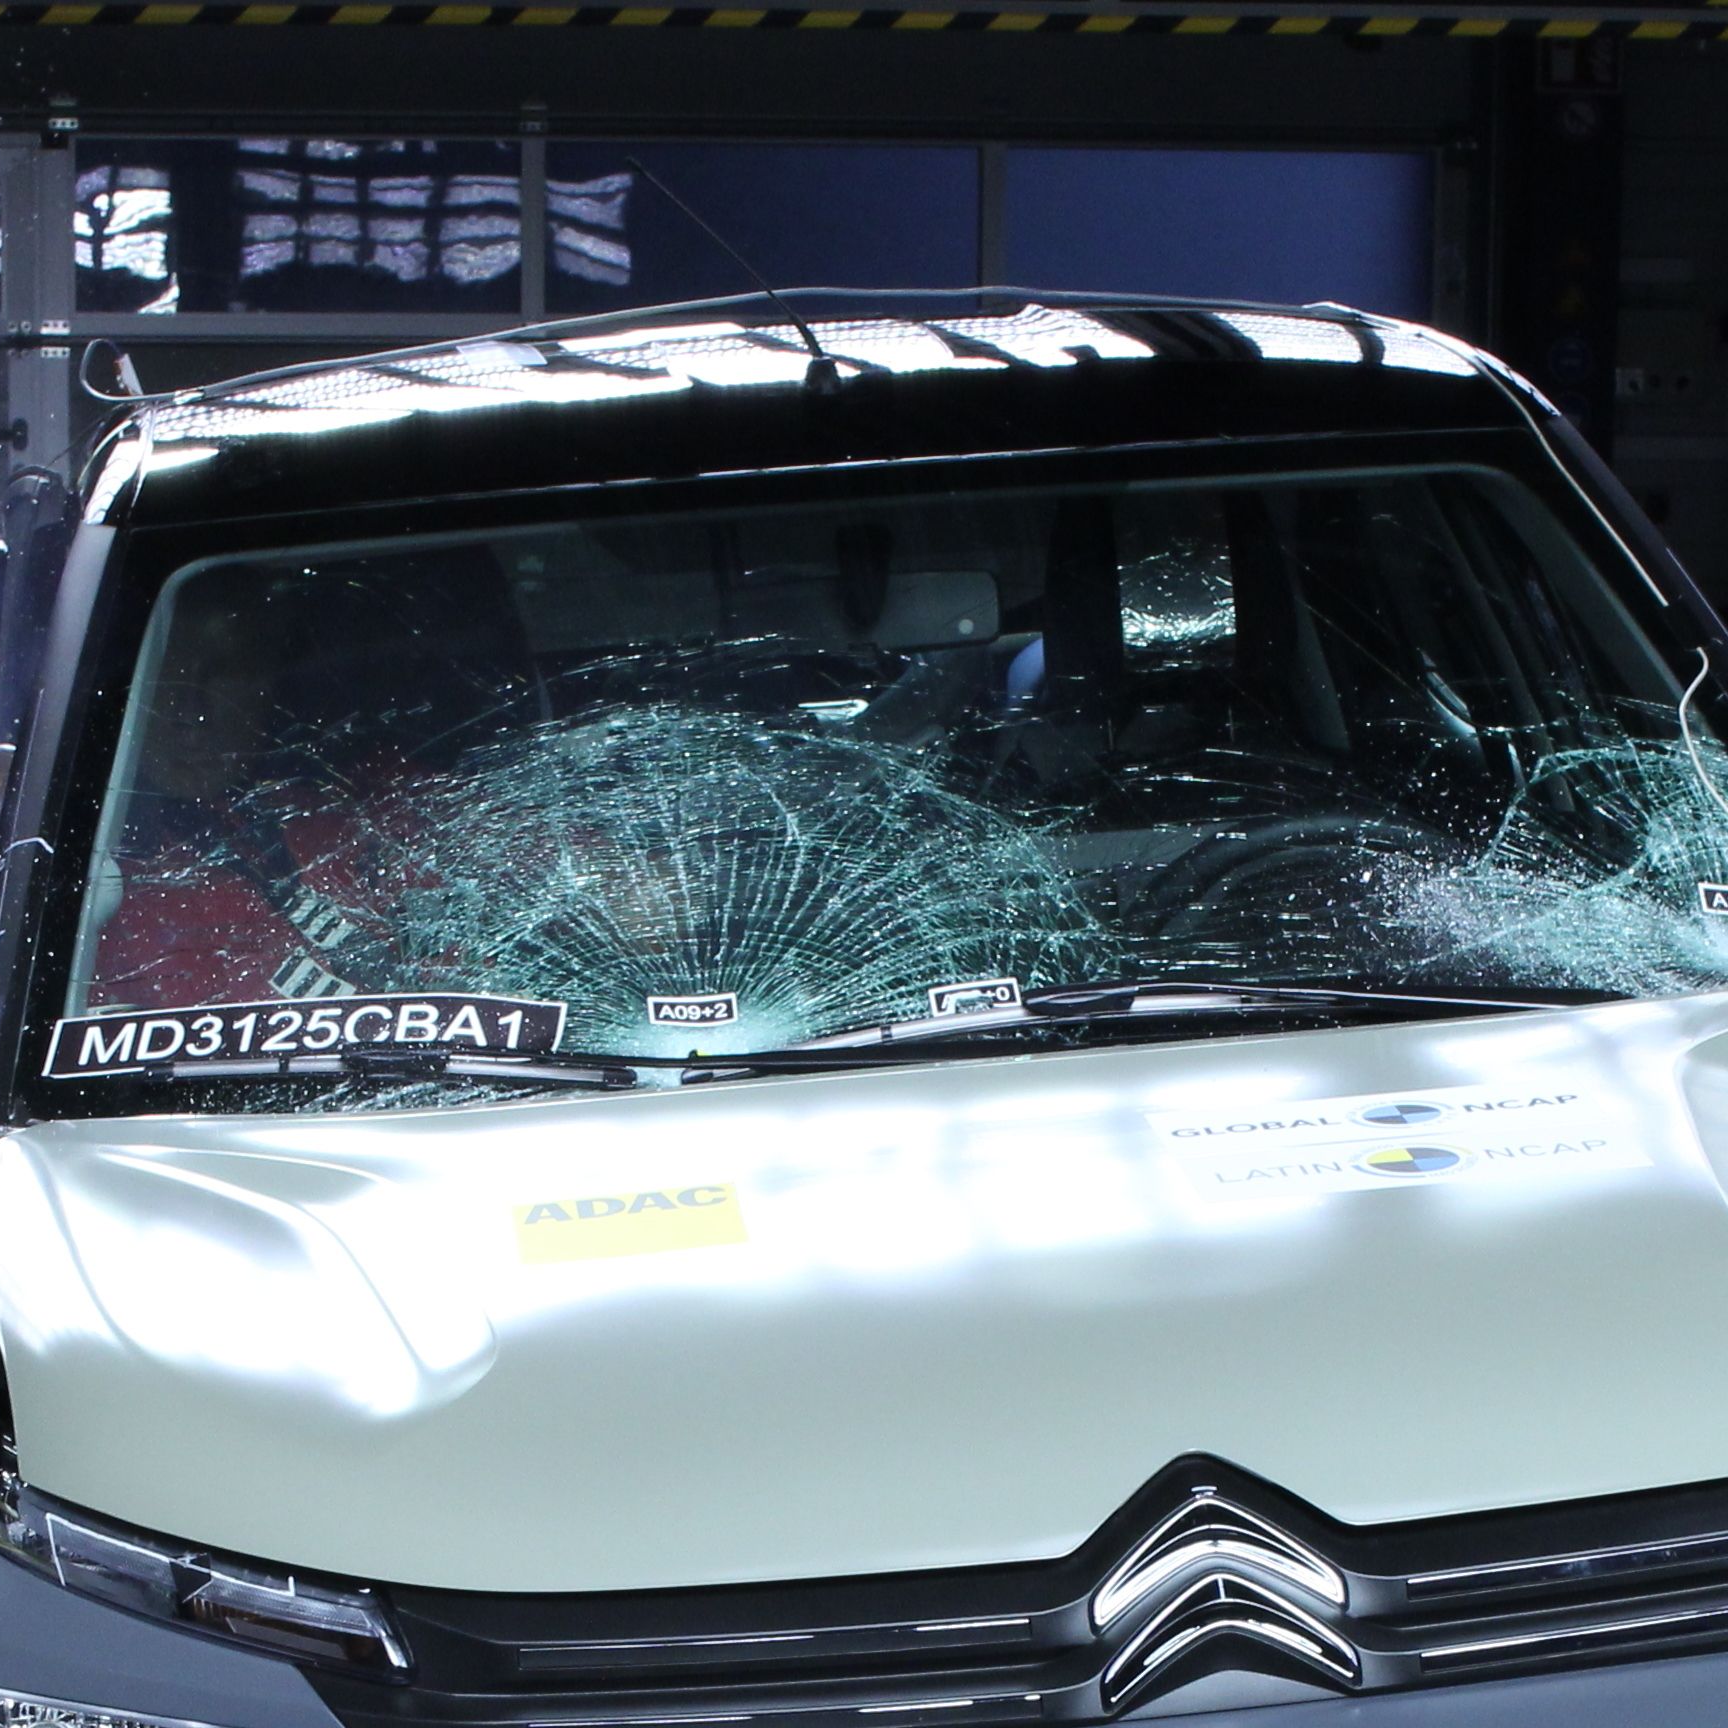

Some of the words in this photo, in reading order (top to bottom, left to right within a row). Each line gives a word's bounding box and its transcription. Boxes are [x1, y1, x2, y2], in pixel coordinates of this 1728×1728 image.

[658, 1002, 728, 1021] A09+2
[77, 1003, 526, 1067] MD3125CBA1
[1171, 1116, 1342, 1138] GLOBAL
[1462, 1094, 1579, 1113] NCAP
[1215, 1161, 1343, 1183] LATIN
[1484, 1138, 1608, 1160] NCAP
[523, 1185, 728, 1225] ADAC
